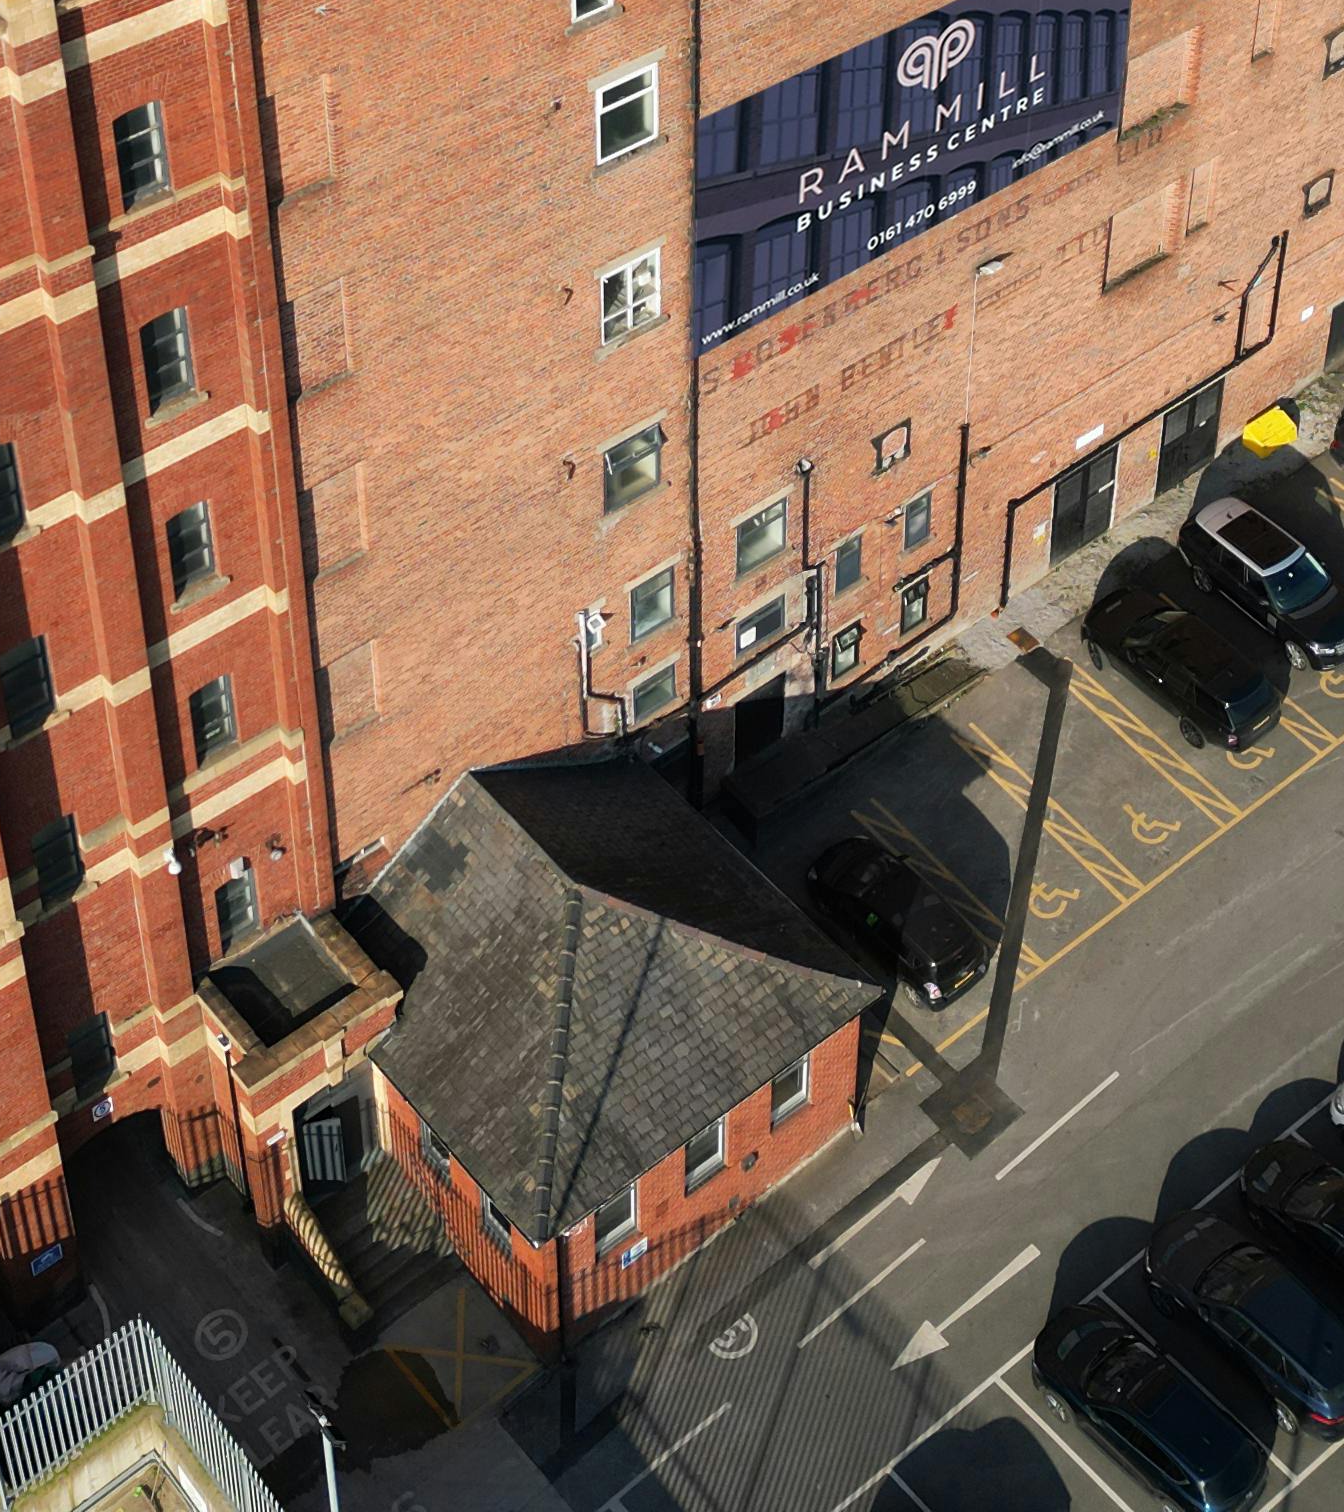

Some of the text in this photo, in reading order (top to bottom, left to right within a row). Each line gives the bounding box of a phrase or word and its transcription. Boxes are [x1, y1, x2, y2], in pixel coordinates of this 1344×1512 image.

[795, 87, 1045, 234] BUSINESS CENTRE
[798, 53, 1046, 203] RAM MILL
[866, 180, 977, 251] 0161 470 6999
[700, 272, 820, 346] www.rammill.co.uk
